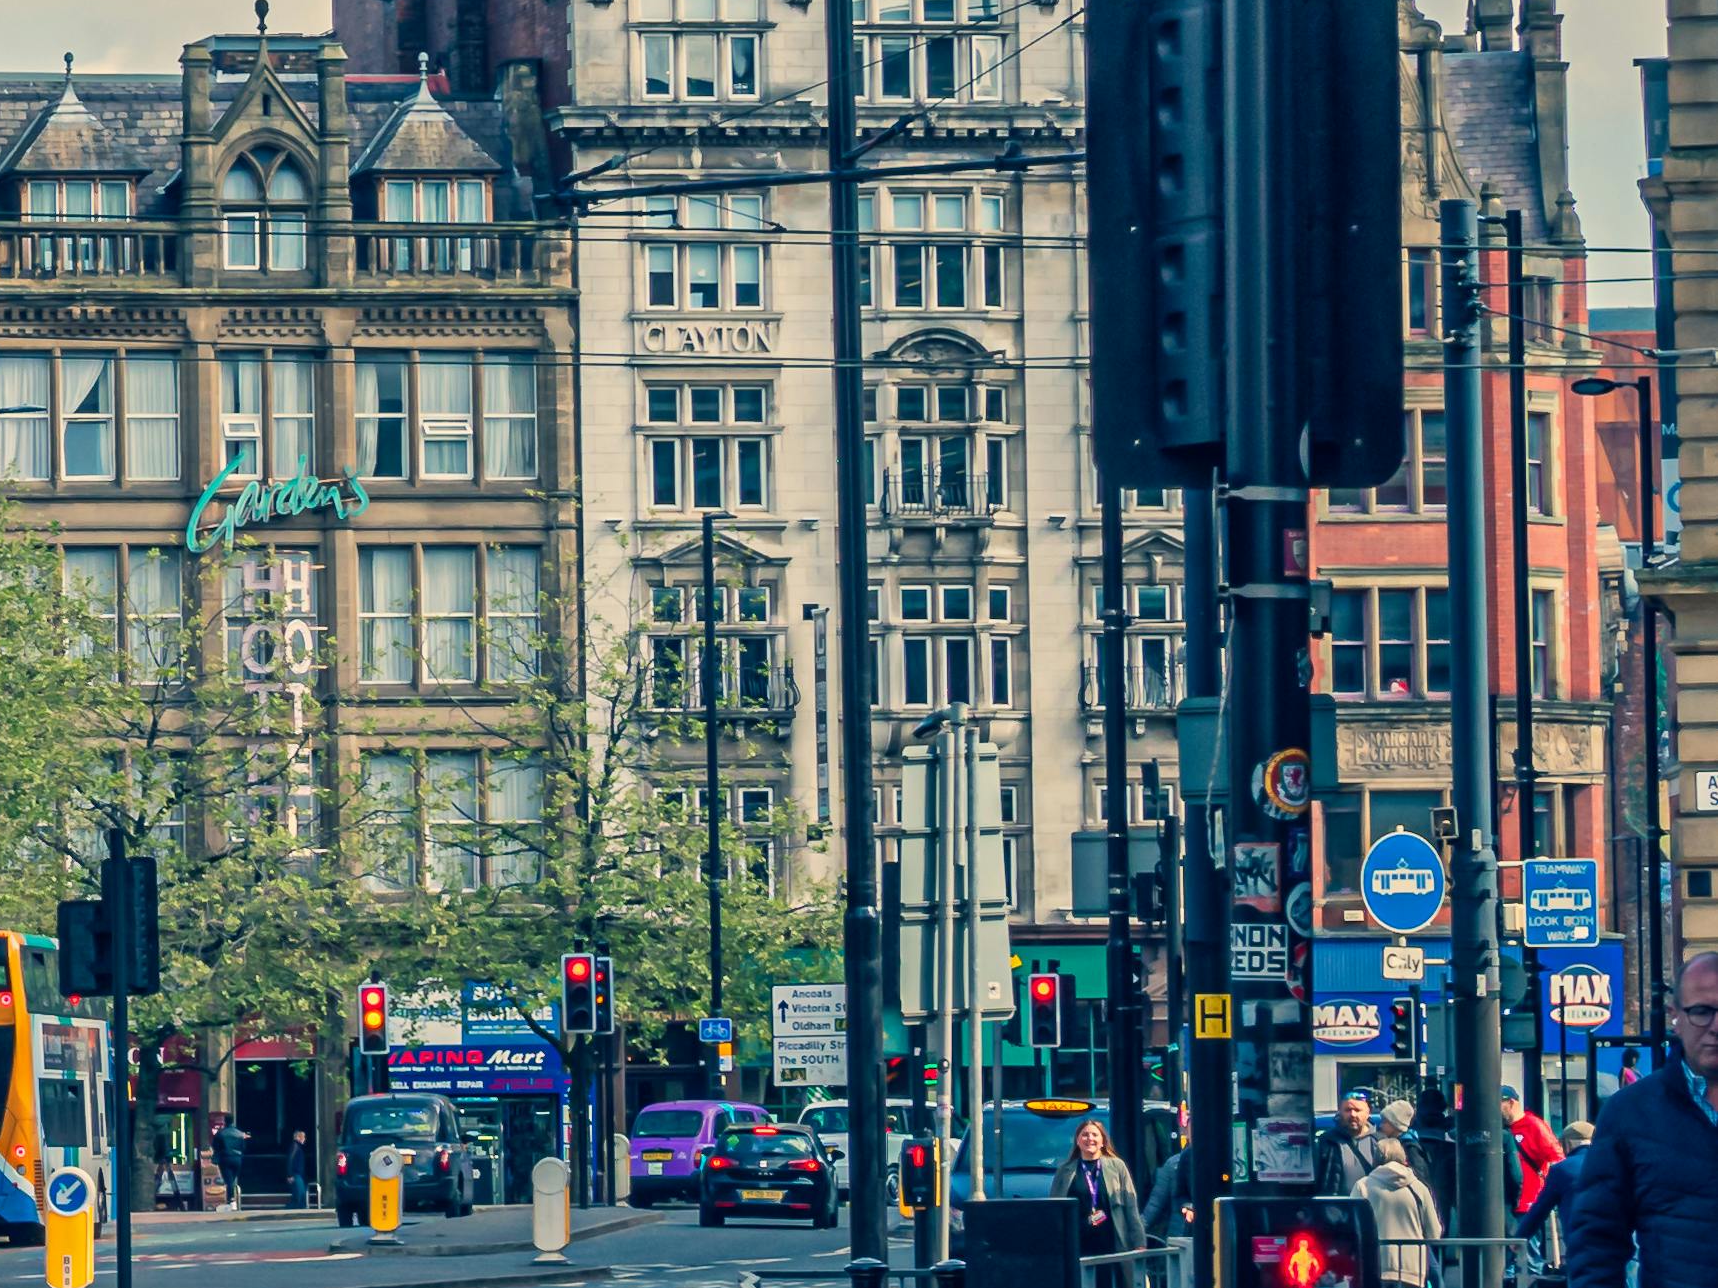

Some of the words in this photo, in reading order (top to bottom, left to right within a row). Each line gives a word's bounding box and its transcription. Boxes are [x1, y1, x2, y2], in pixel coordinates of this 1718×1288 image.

[644, 320, 781, 353] CLAYTON
[1534, 864, 1588, 875] TRAMWAY
[1529, 916, 1559, 926] LOOK
[1563, 915, 1594, 926] BOTH
[1386, 952, 1421, 973] Oly
[792, 990, 832, 998] Ancoats
[1550, 974, 1611, 1005] MAX
[792, 1003, 830, 1013] Victoria
[1200, 999, 1227, 1033] H
[1312, 1005, 1380, 1026] MAX
[792, 1022, 831, 1031] Oldham
[778, 1041, 826, 1051] Piccadilly
[486, 1049, 546, 1065] Mart
[779, 1055, 797, 1065] The
[801, 1054, 839, 1065] SOUTH
[391, 1080, 410, 1090] SELL
[412, 1080, 452, 1089] EXCHANGE
[457, 1080, 484, 1089] REPAIR
[1044, 1102, 1073, 1110] TAXI
